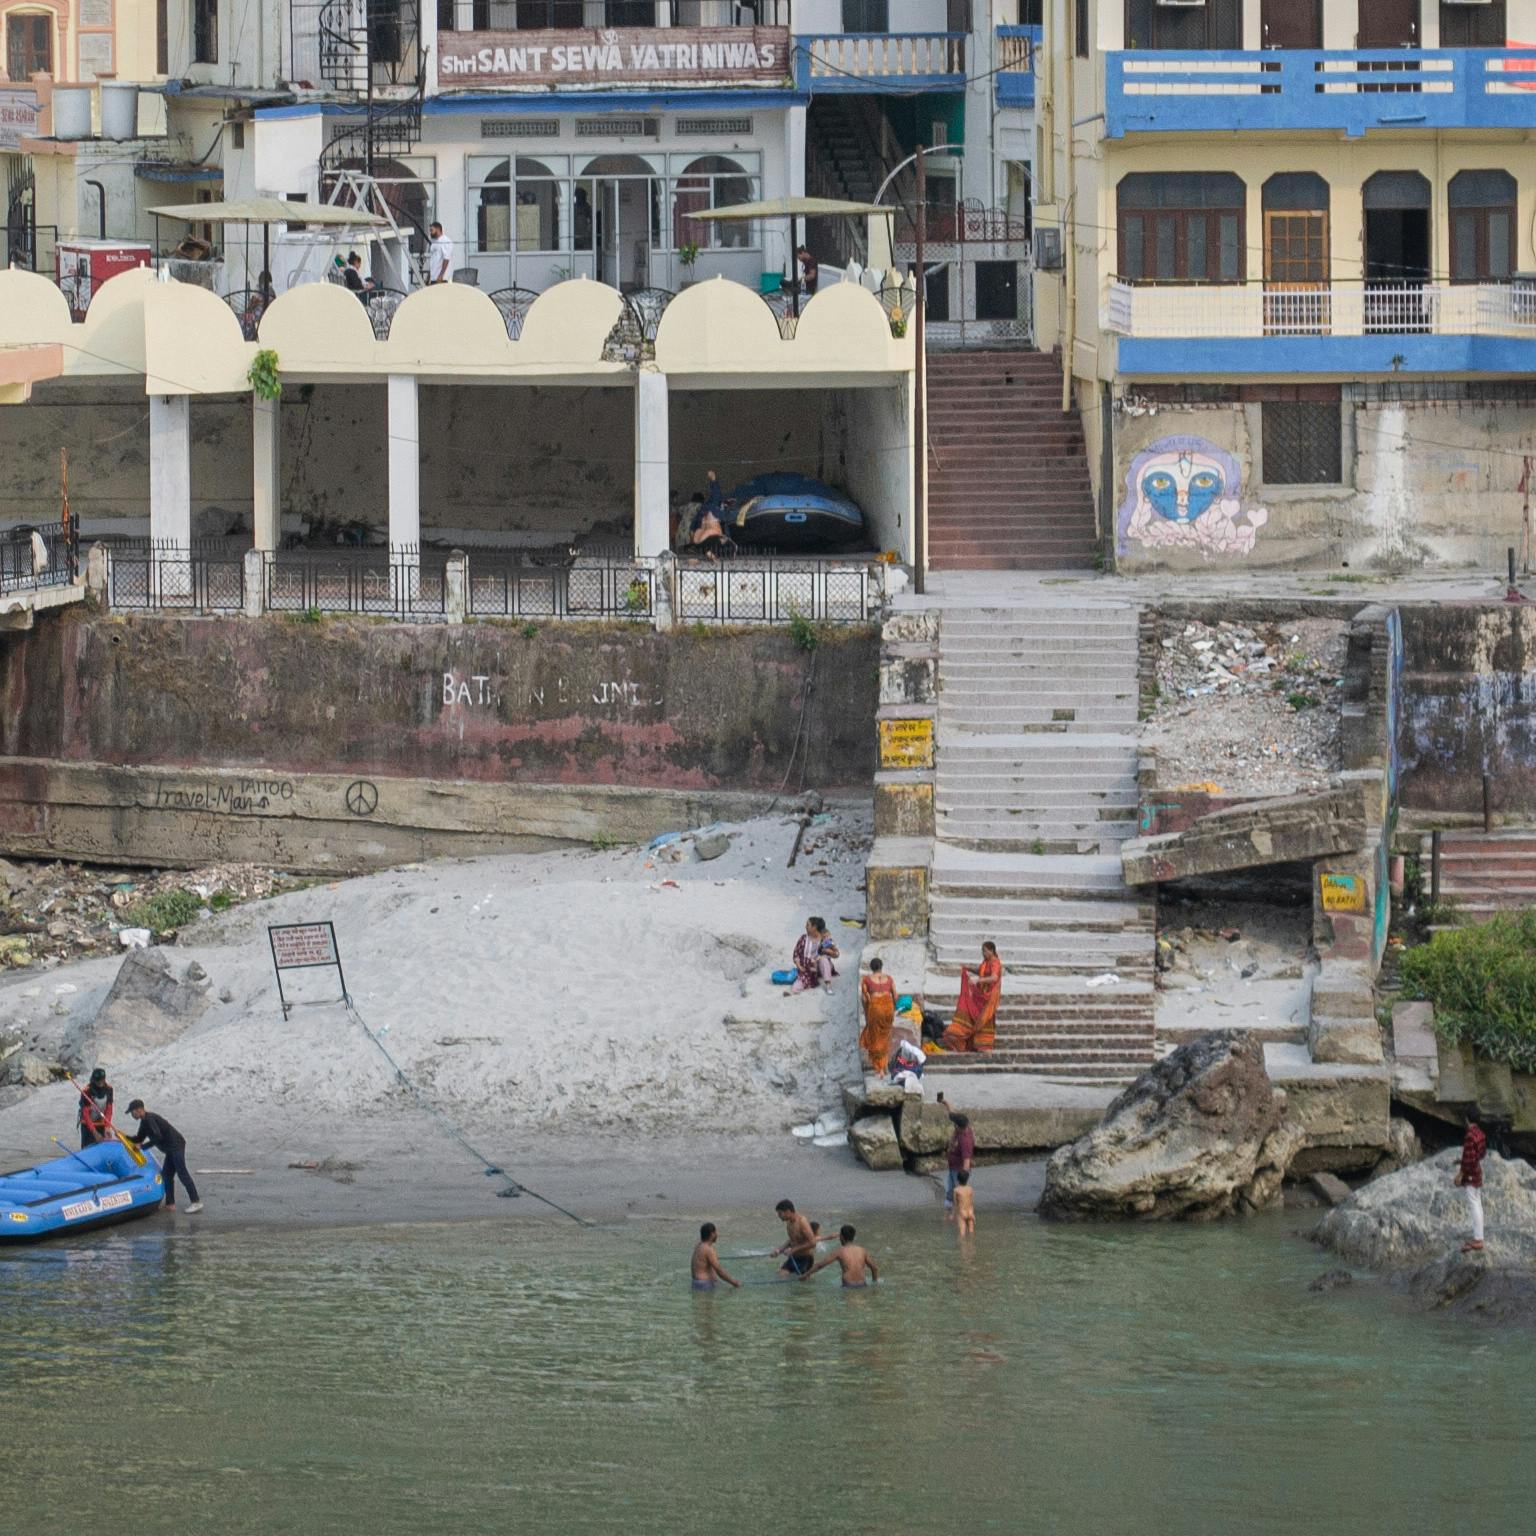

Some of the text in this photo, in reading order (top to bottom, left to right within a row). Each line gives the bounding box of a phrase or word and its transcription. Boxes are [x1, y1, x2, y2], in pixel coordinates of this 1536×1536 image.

[442, 43, 776, 74] Shri SANT SEWA YATRI NIWAS
